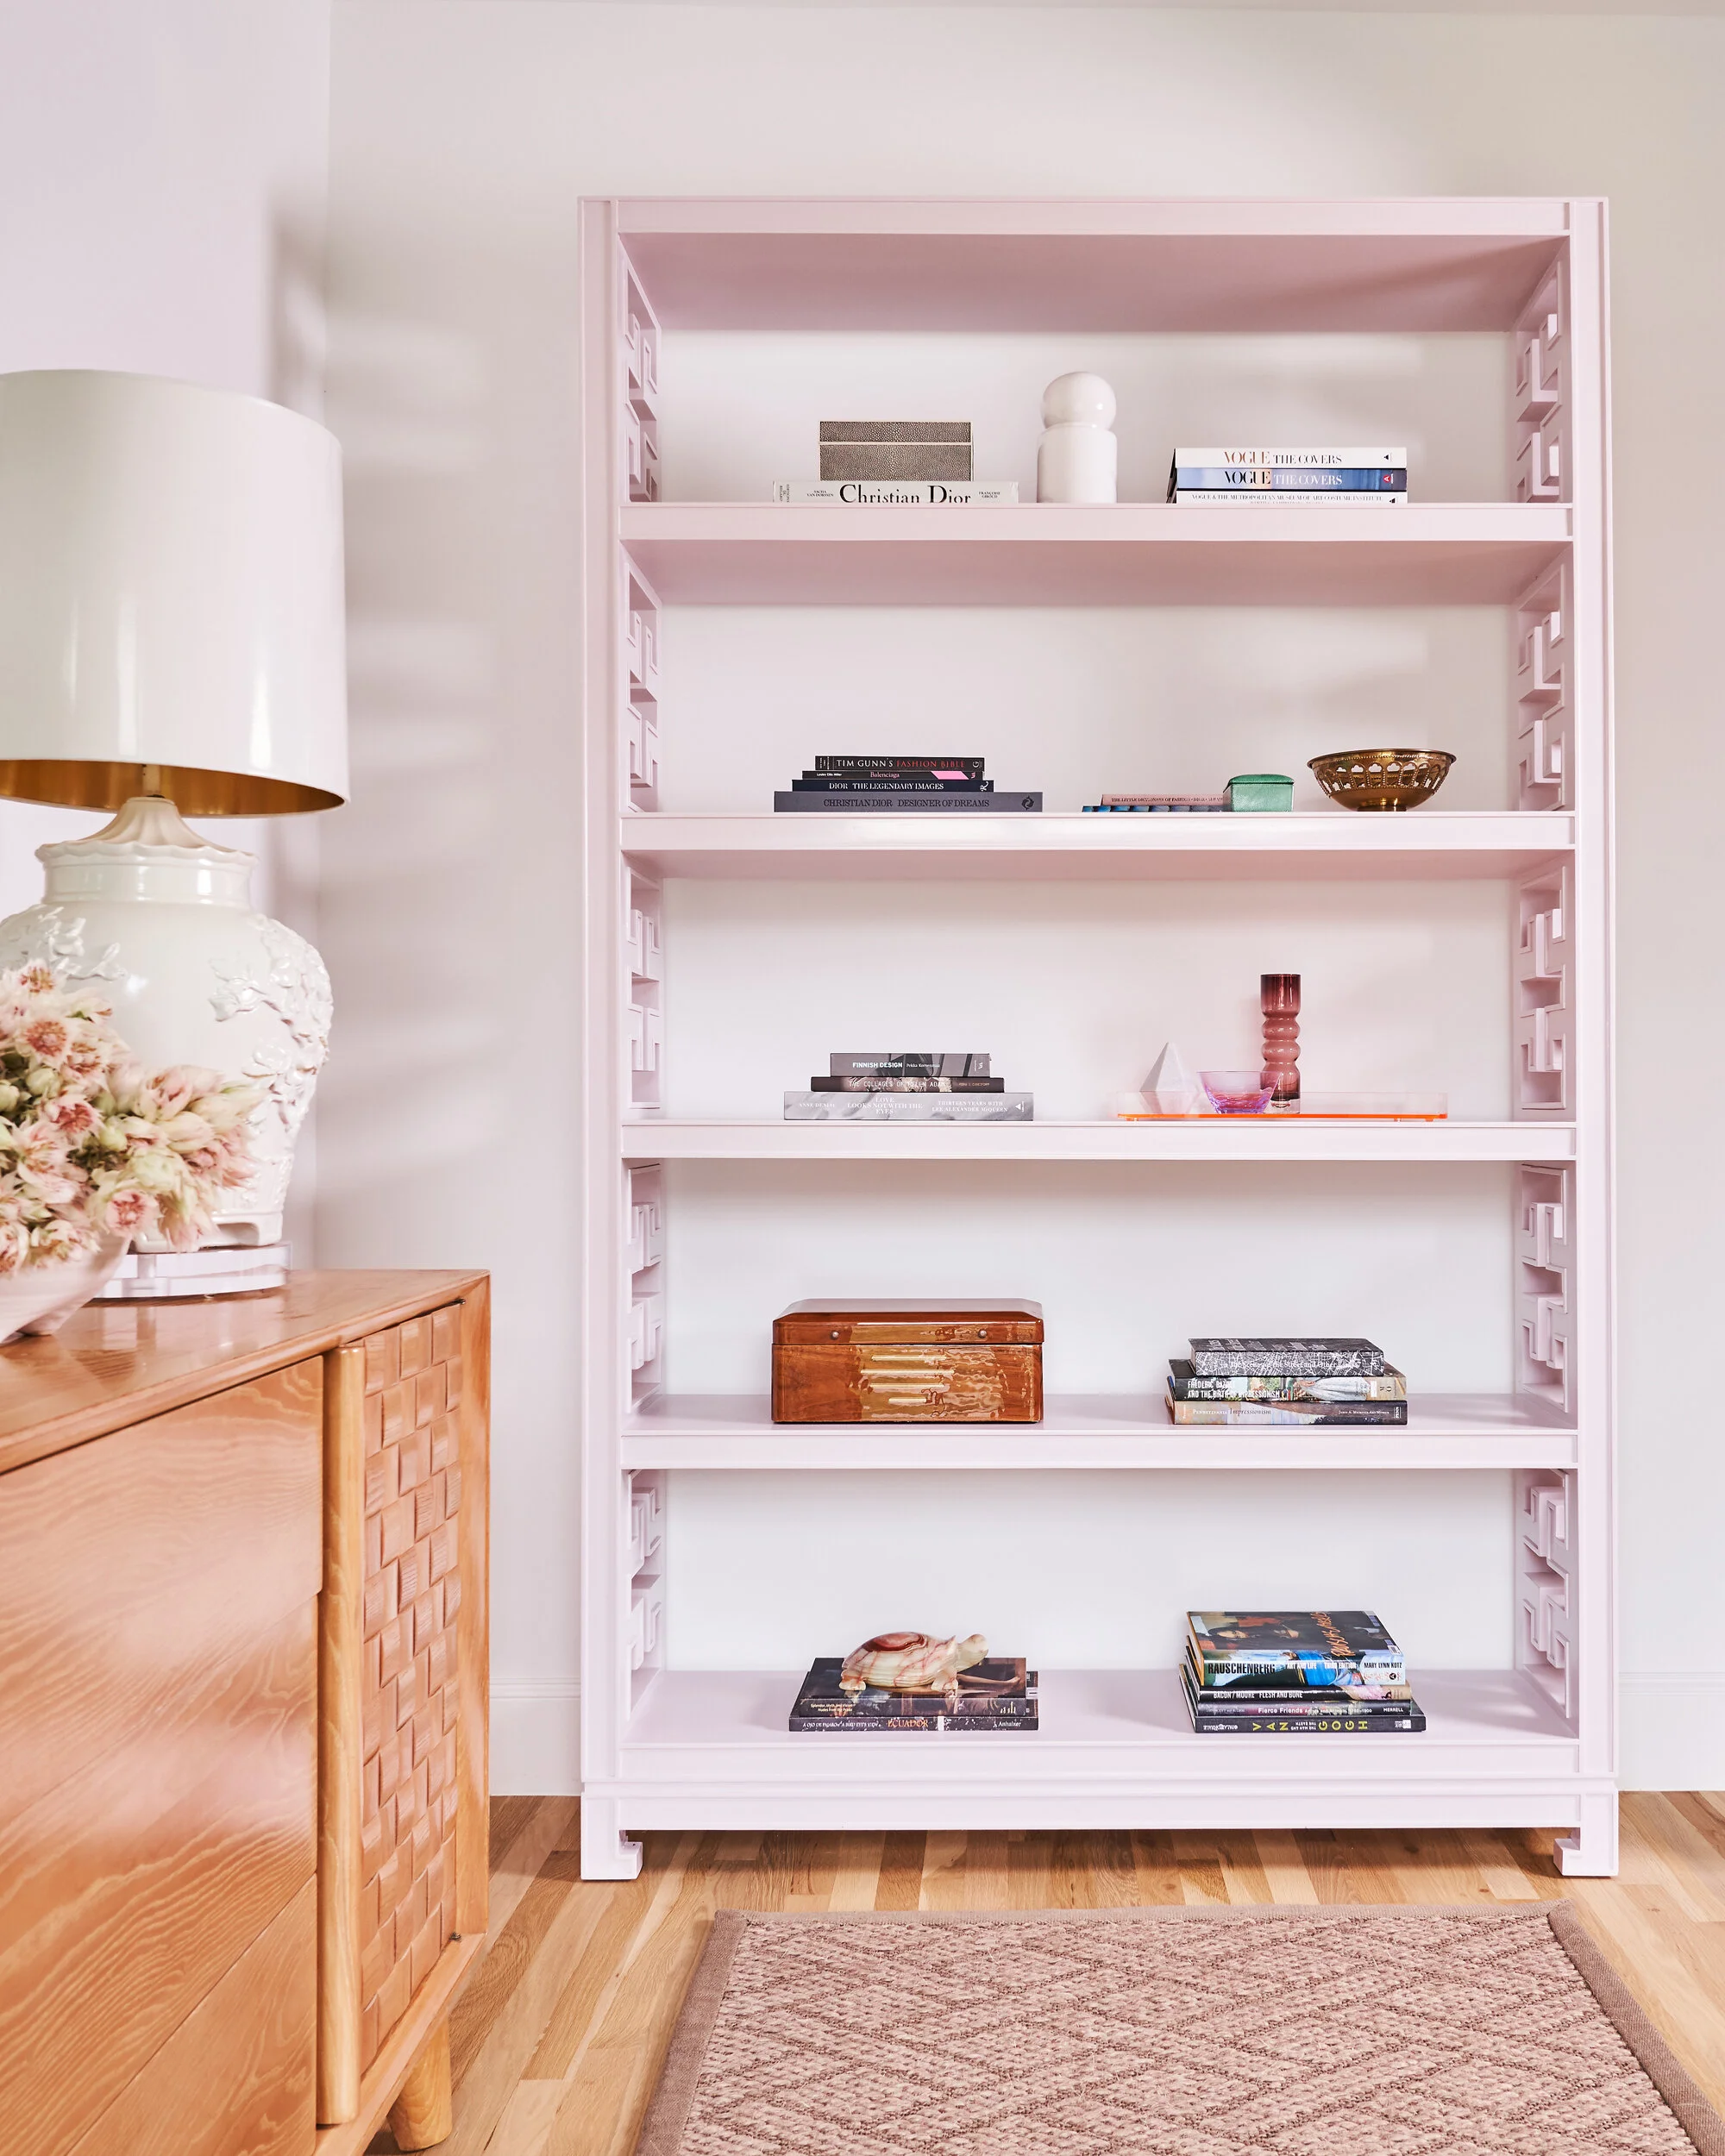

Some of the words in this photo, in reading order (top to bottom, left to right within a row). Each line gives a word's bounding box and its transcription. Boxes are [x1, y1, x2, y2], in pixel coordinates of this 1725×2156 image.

[1224, 451, 1270, 464] VOGUE
[1273, 454, 1296, 464] THE
[1298, 454, 1342, 464] COVERS
[1224, 471, 1271, 485] VOGUE
[1273, 474, 1297, 485] THE
[1298, 474, 1343, 486] COVERS
[839, 484, 920, 503] Christian
[927, 485, 972, 503] Dior
[857, 758, 894, 768] GUNN'S
[823, 799, 871, 807] CHRISTIAN
[872, 799, 893, 807] DIOR
[897, 799, 942, 807] DESIGNER
[1229, 1407, 1271, 1417] Impressionism
[1208, 1663, 1276, 1674] RAUSCHENBERG
[888, 1720, 929, 1728] ECUADOR
